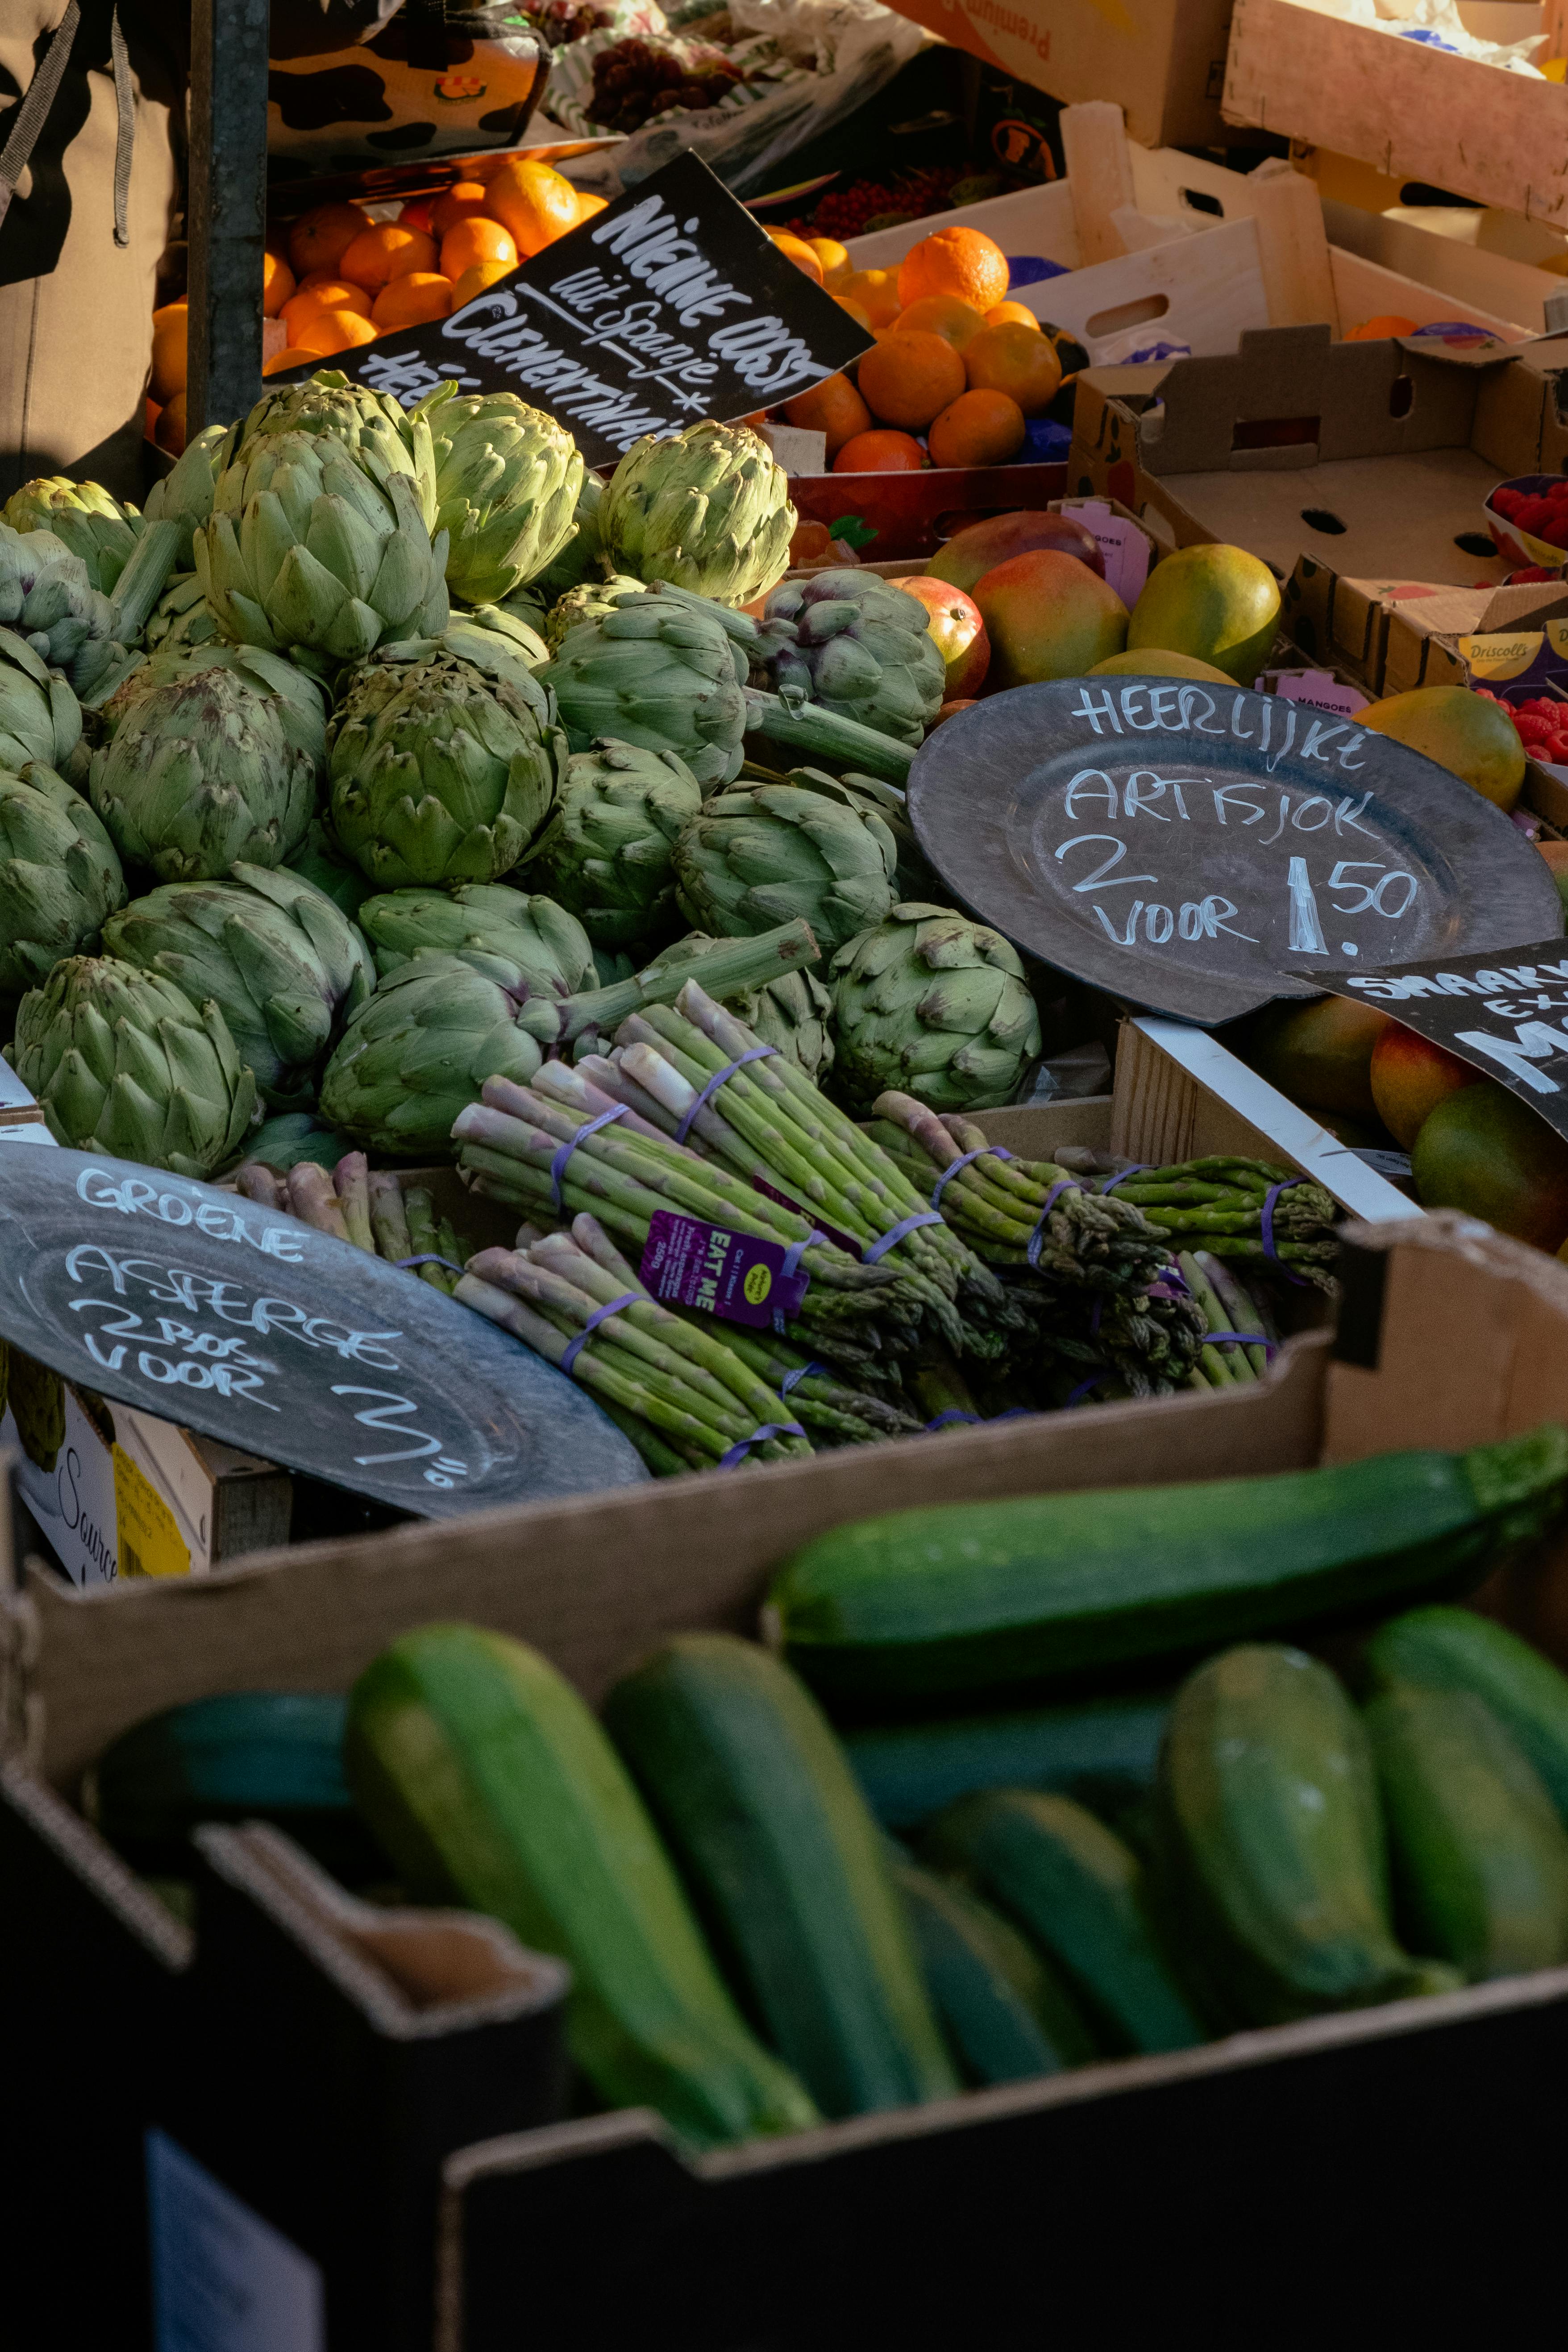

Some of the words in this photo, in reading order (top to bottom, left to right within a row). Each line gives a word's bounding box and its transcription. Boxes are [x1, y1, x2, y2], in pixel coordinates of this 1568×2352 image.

[581, 300, 720, 384] Spanje
[1471, 643, 1527, 658] Driscoll's
[1298, 696, 1352, 713] MANGOES
[1054, 833, 1159, 892] 2
[1092, 895, 1260, 946] VOOR
[1482, 990, 1568, 1019] EX
[1453, 1015, 1568, 1095] M
[650, 1240, 667, 1270] 250g
[704, 1230, 732, 1277] EAT
[65, 1244, 403, 1371] ASPERGE
[695, 1278, 719, 1311] ME
[68, 1298, 178, 1345] 2
[84, 1333, 281, 1412] VOOR
